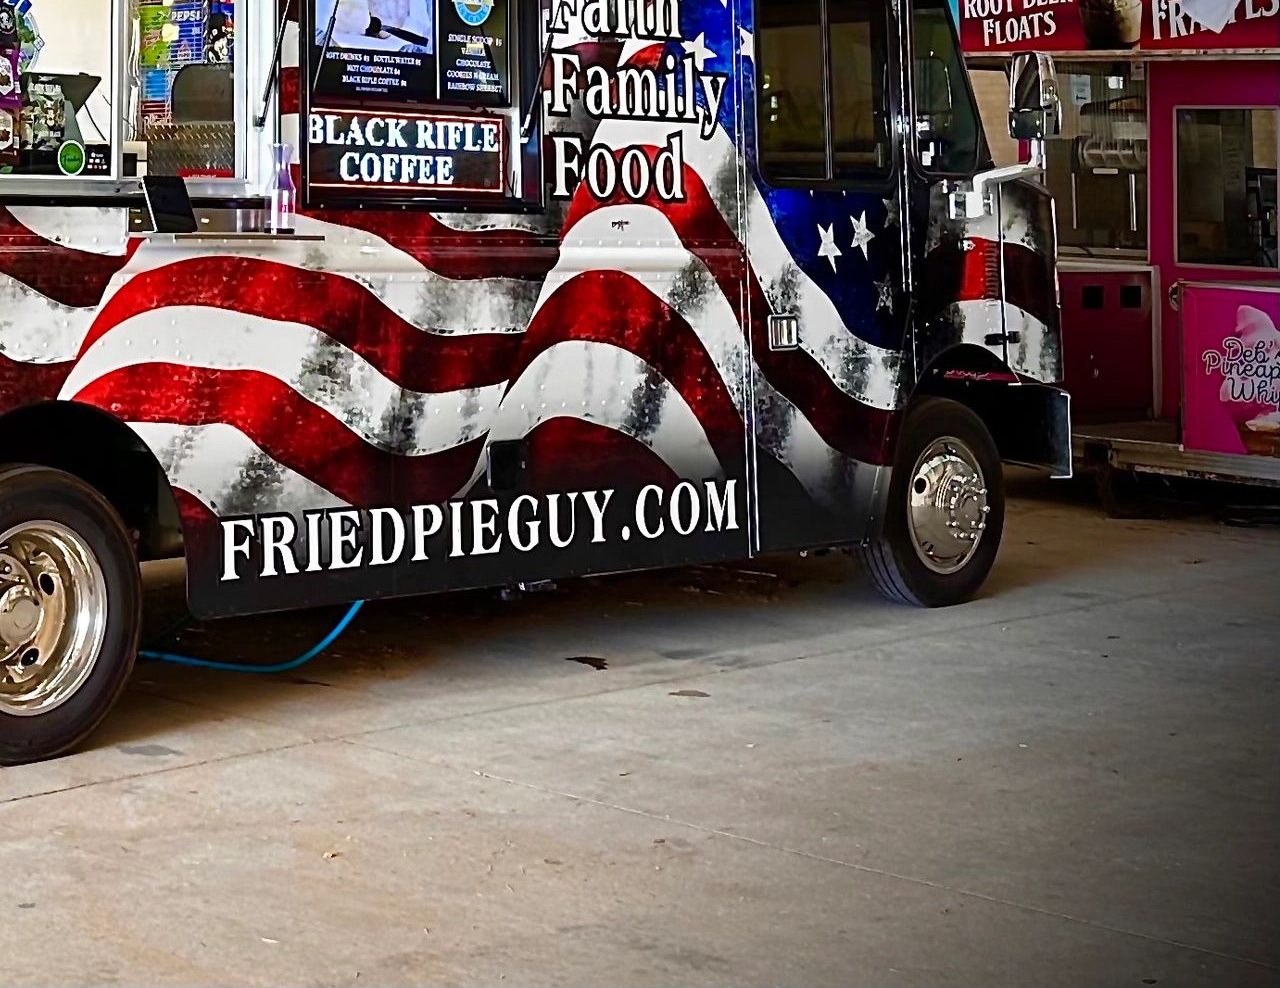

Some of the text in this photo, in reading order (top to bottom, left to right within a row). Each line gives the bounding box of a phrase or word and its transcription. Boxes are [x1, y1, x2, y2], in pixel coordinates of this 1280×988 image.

[171, 9, 201, 22] PEPSI
[983, 10, 1057, 47] FLOATS
[551, 53, 727, 137] Family
[308, 113, 499, 153] BLACK RIFLE
[339, 152, 455, 185] COFFEE
[552, 135, 685, 201] Food
[219, 478, 740, 582] FRIEDPIEGUY.COM
